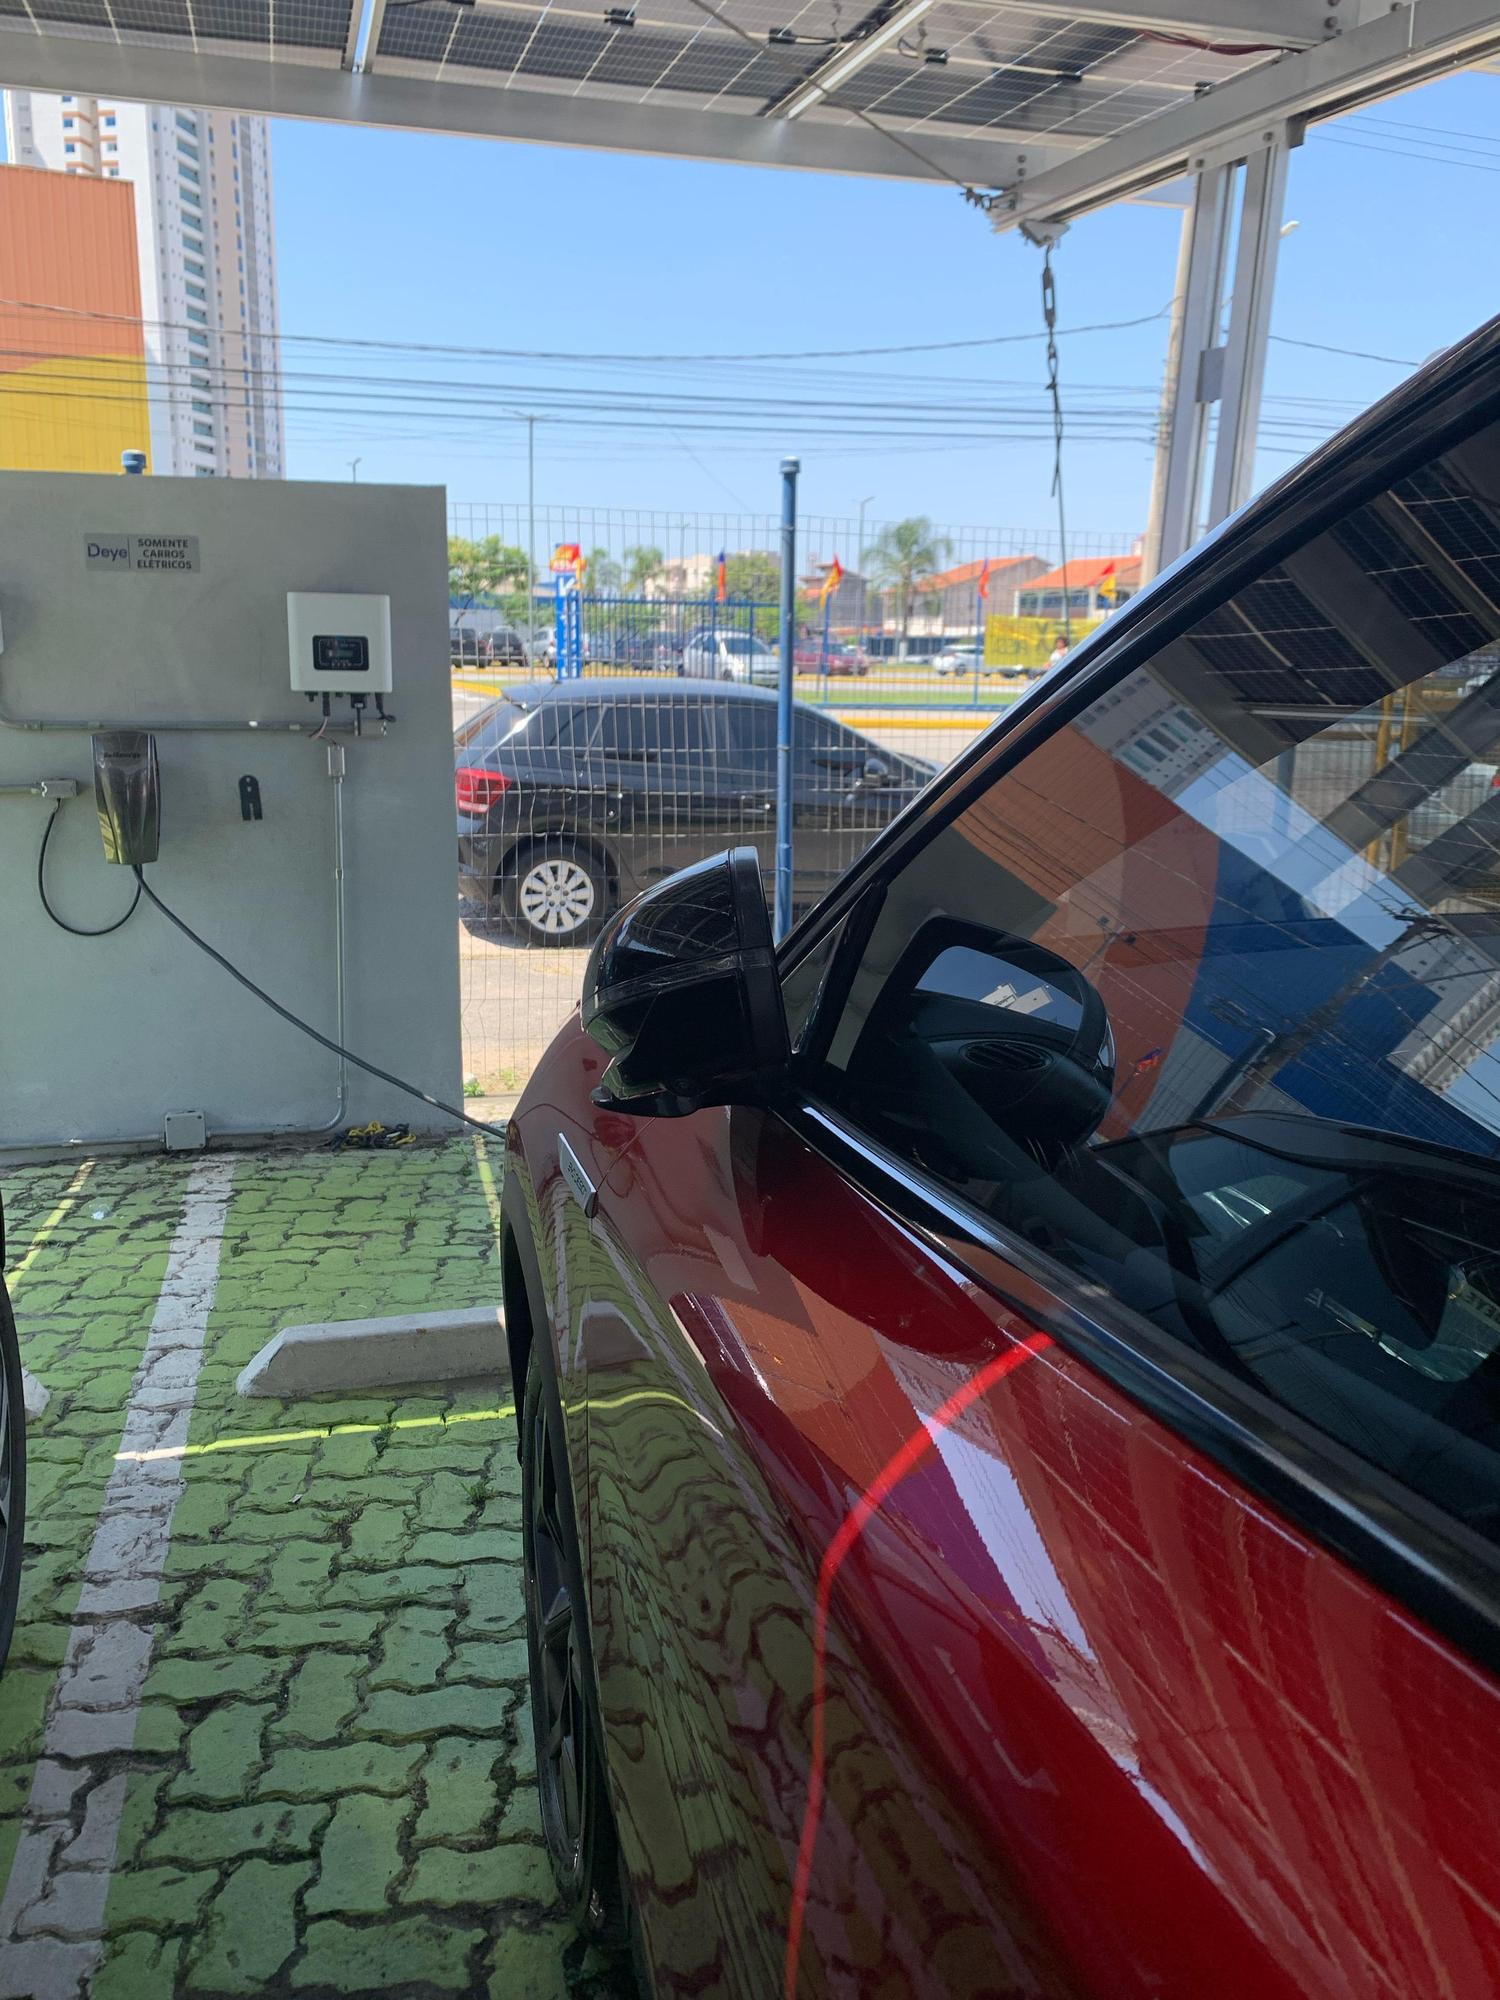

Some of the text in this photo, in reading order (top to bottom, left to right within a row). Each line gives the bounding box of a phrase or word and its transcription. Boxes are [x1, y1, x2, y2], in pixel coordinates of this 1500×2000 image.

[138, 538, 189, 548] SOMENTE
[87, 542, 128, 561] Deye
[142, 549, 185, 560] CARROS
